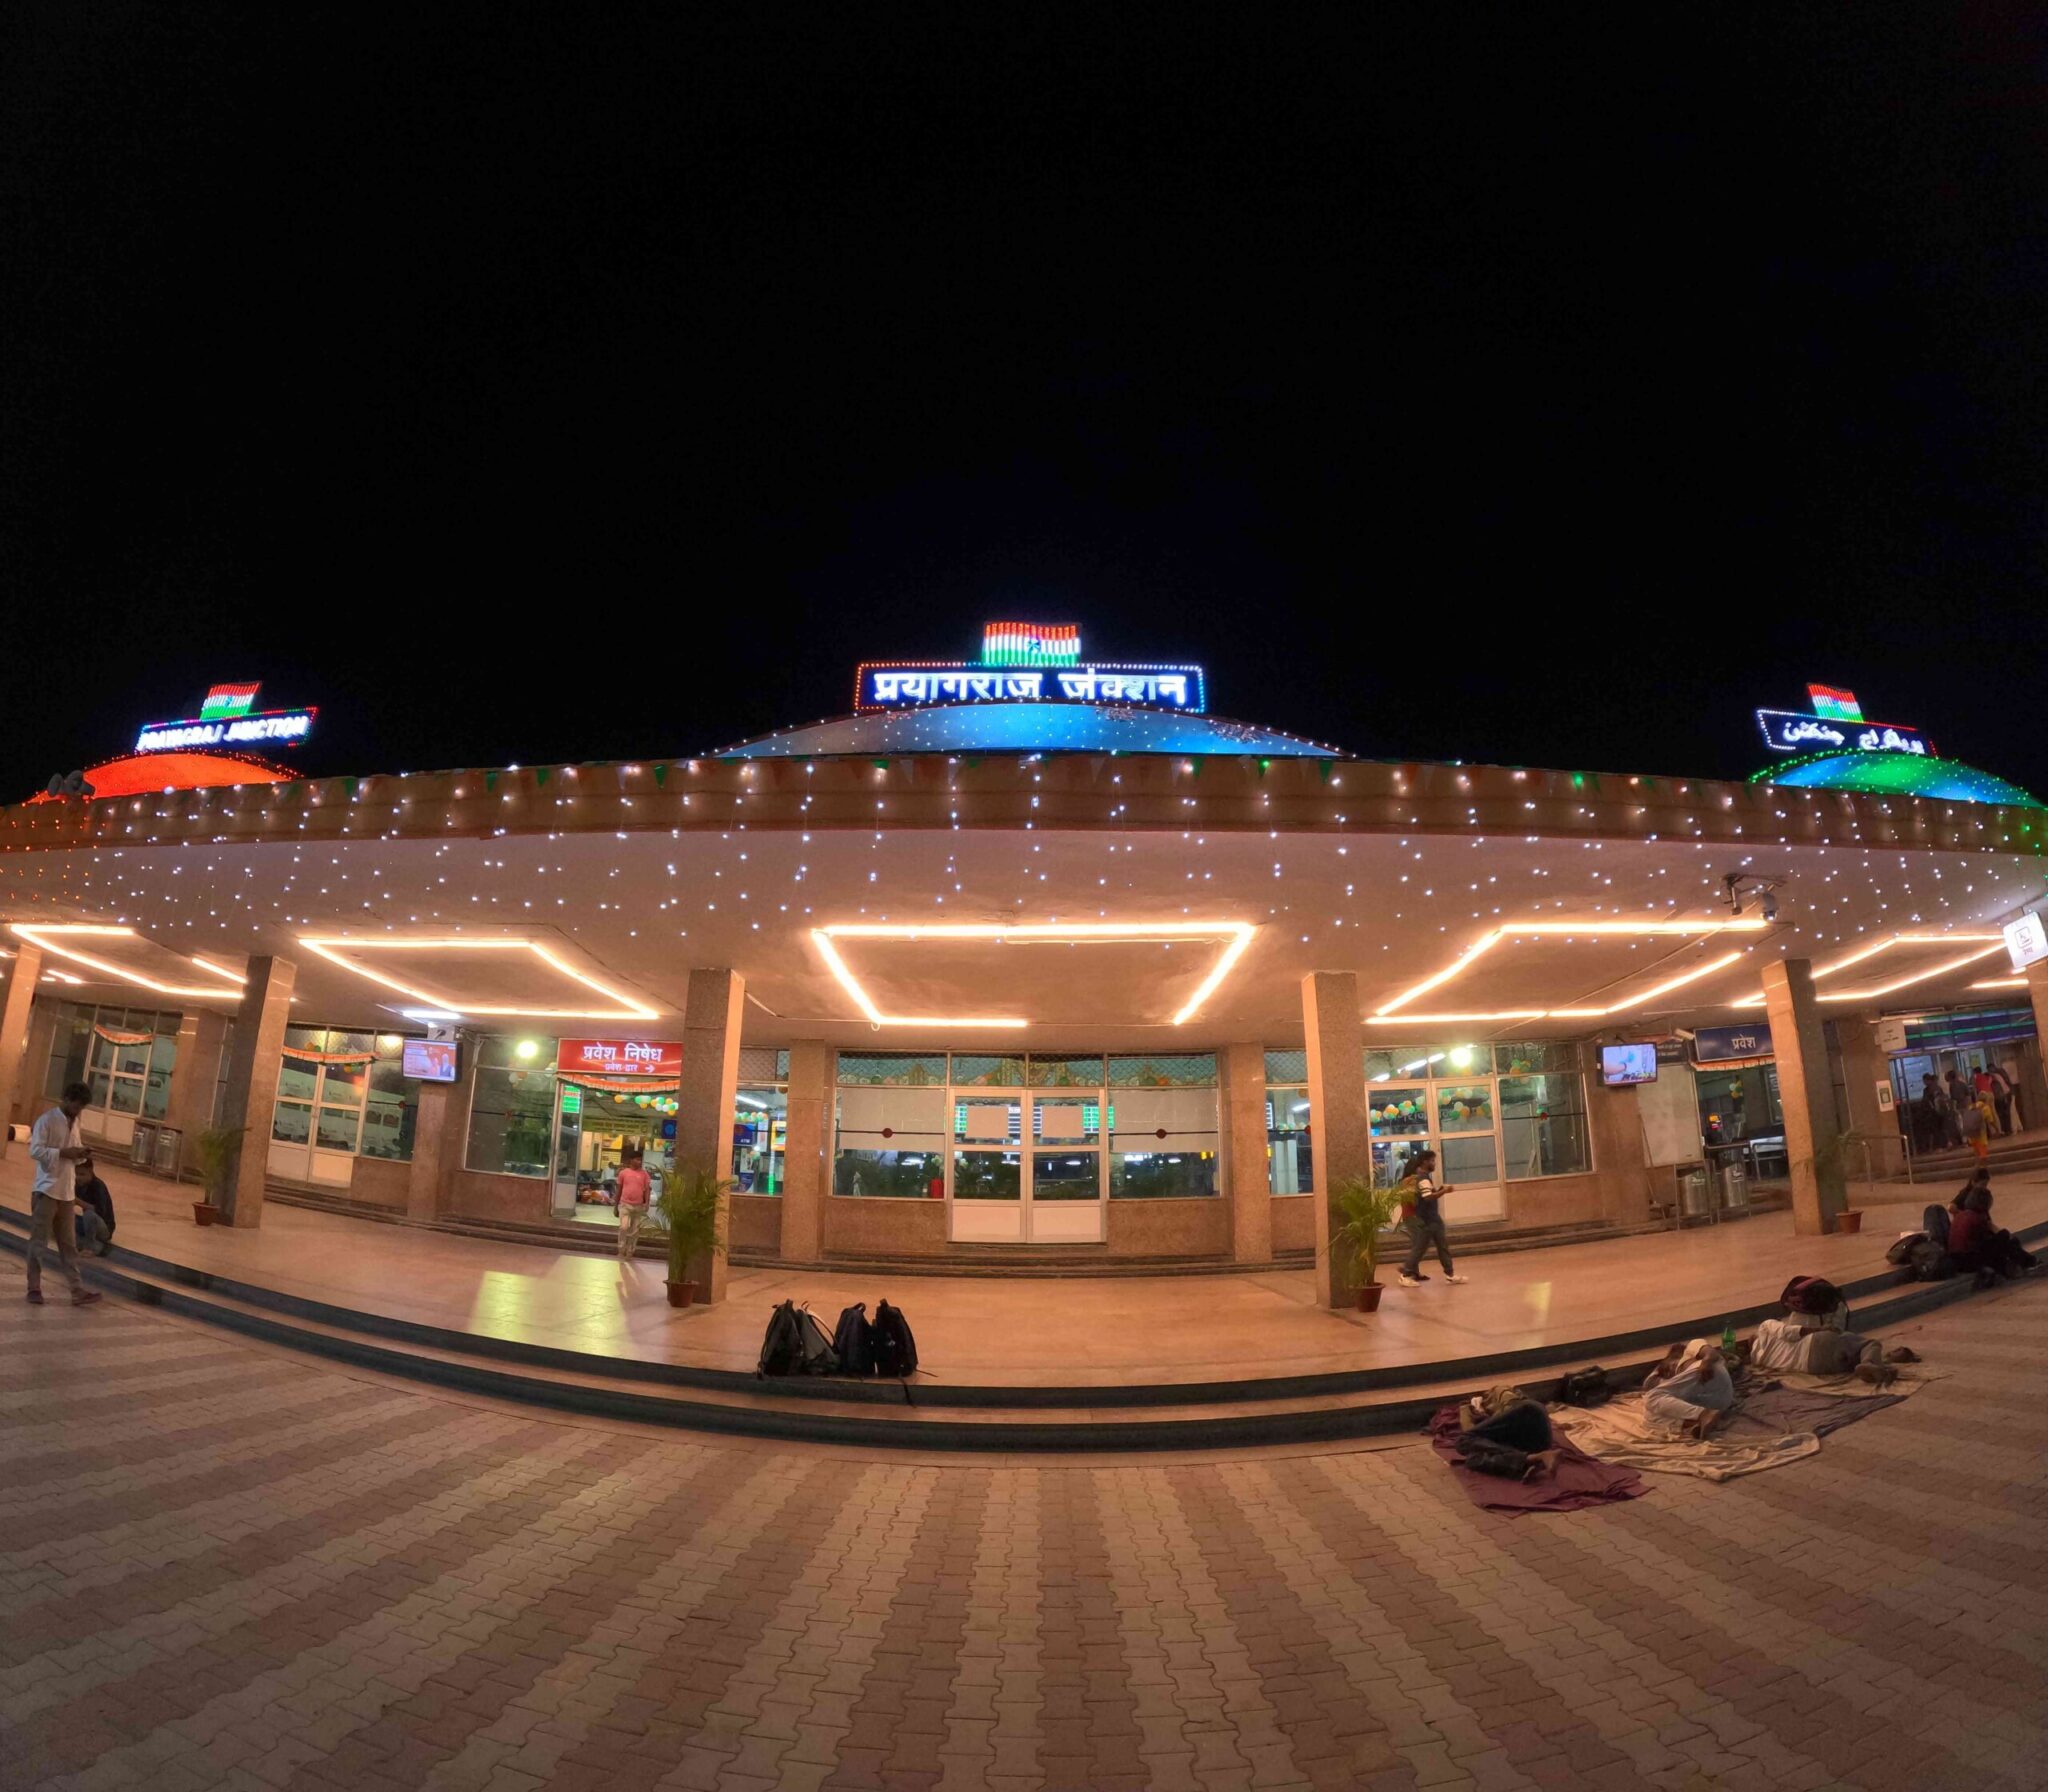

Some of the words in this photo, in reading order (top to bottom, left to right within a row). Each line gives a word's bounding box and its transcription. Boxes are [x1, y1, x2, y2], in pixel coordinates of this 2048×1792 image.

[872, 671, 1044, 701] प्रयागराज
[1057, 667, 1189, 705] जंक्शन
[136, 725, 224, 751] PRAYAGRAJ
[223, 715, 310, 743] JUNCTION
[583, 1042, 616, 1060] प्रवेश
[624, 1042, 663, 1062] निषेध
[1731, 1034, 1756, 1050] प्रवेश
